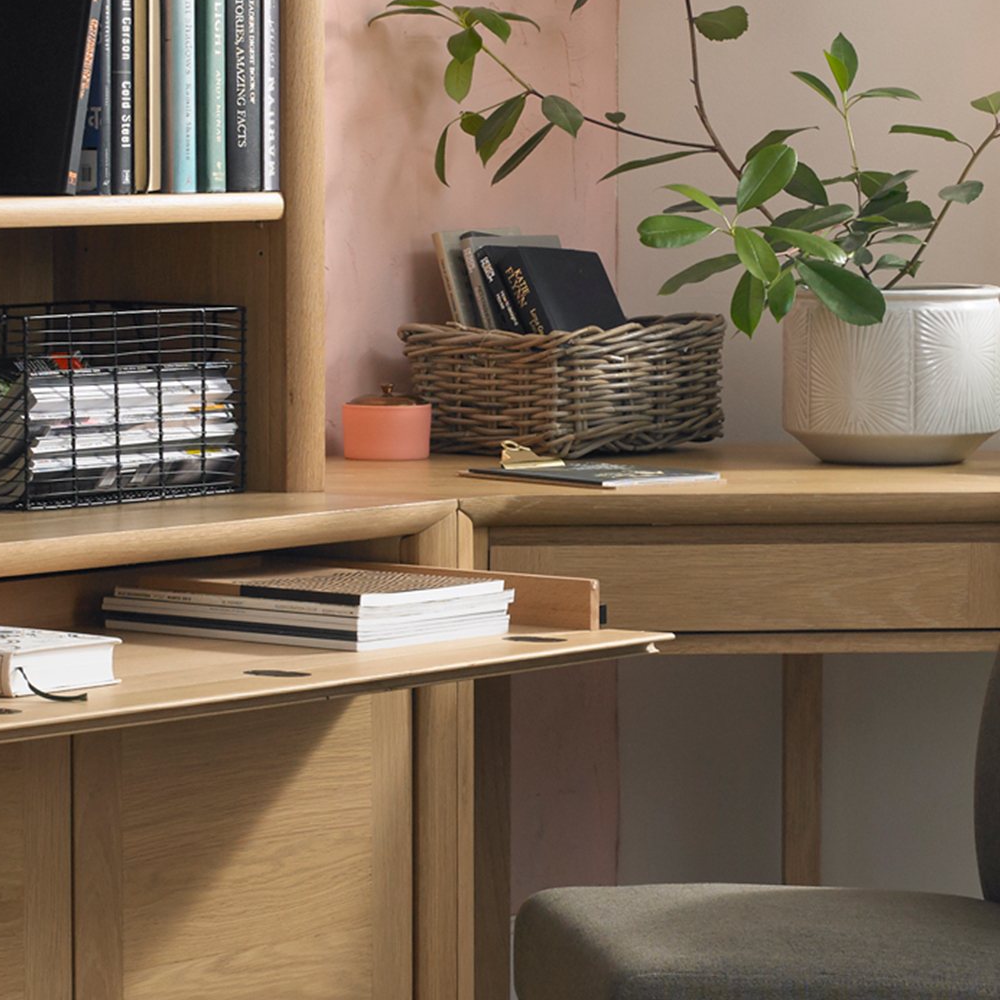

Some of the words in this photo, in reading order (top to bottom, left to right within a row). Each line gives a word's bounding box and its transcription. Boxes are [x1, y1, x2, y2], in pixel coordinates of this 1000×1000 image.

[122, 17, 131, 60] Carson
[214, 2, 222, 56] LIGHT
[121, 81, 131, 109] Cold
[236, 47, 245, 106] AMAZING
[248, 91, 255, 104] OF
[121, 115, 130, 148] Steel
[237, 110, 246, 149] FACTS
[268, 76, 276, 176] MARILYN
[504, 266, 528, 308] FLYNN
[513, 267, 530, 295] KATIE
